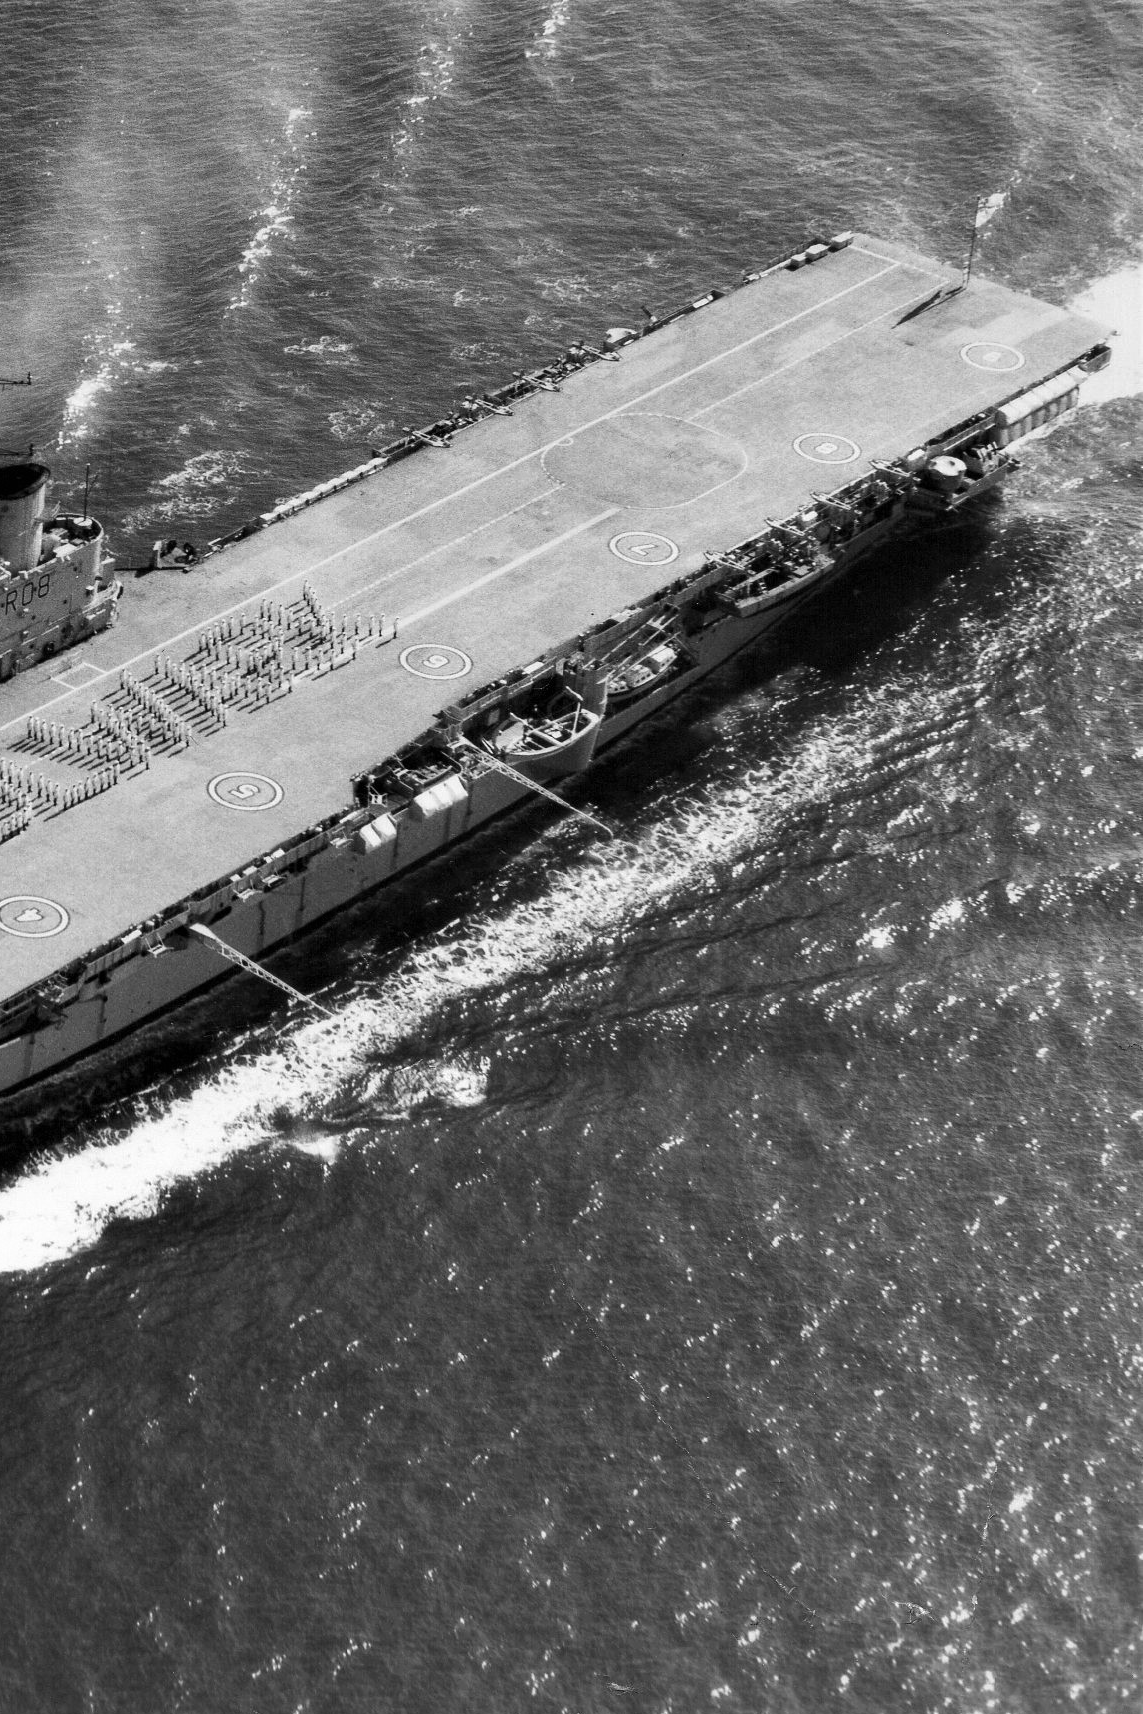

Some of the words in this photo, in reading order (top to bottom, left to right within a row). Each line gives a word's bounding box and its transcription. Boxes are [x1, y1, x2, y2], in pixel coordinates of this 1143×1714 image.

[815, 442, 838, 454] 8
[629, 543, 658, 556] 7
[422, 653, 450, 669] 6
[228, 783, 261, 799] 5
[15, 906, 44, 923] 4
